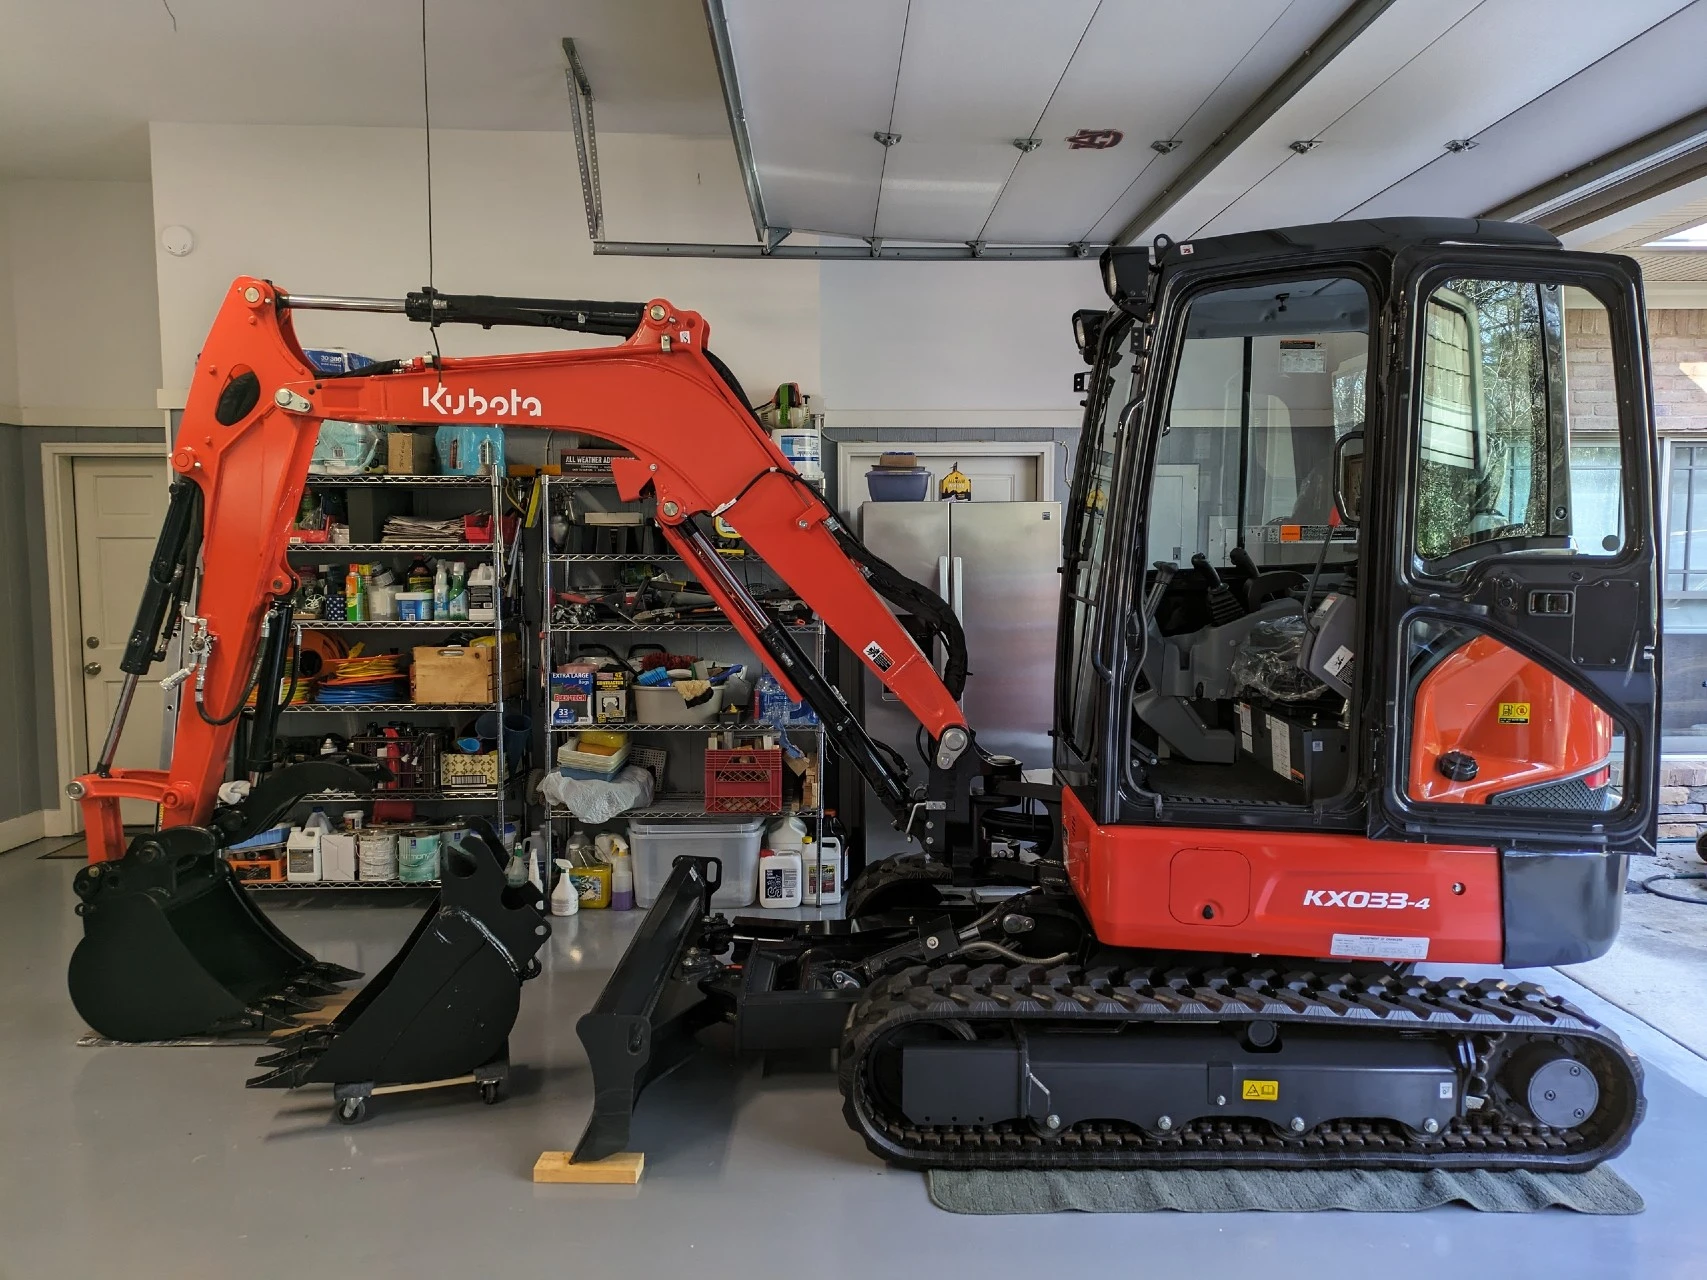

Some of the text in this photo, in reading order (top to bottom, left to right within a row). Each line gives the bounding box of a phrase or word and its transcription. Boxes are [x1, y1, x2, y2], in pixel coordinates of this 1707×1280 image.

[422, 382, 542, 416] Kubota
[565, 455, 576, 463] ALL
[576, 456, 602, 464] WEATHER
[558, 708, 569, 716] 33
[1303, 890, 1430, 910] KX033-4
